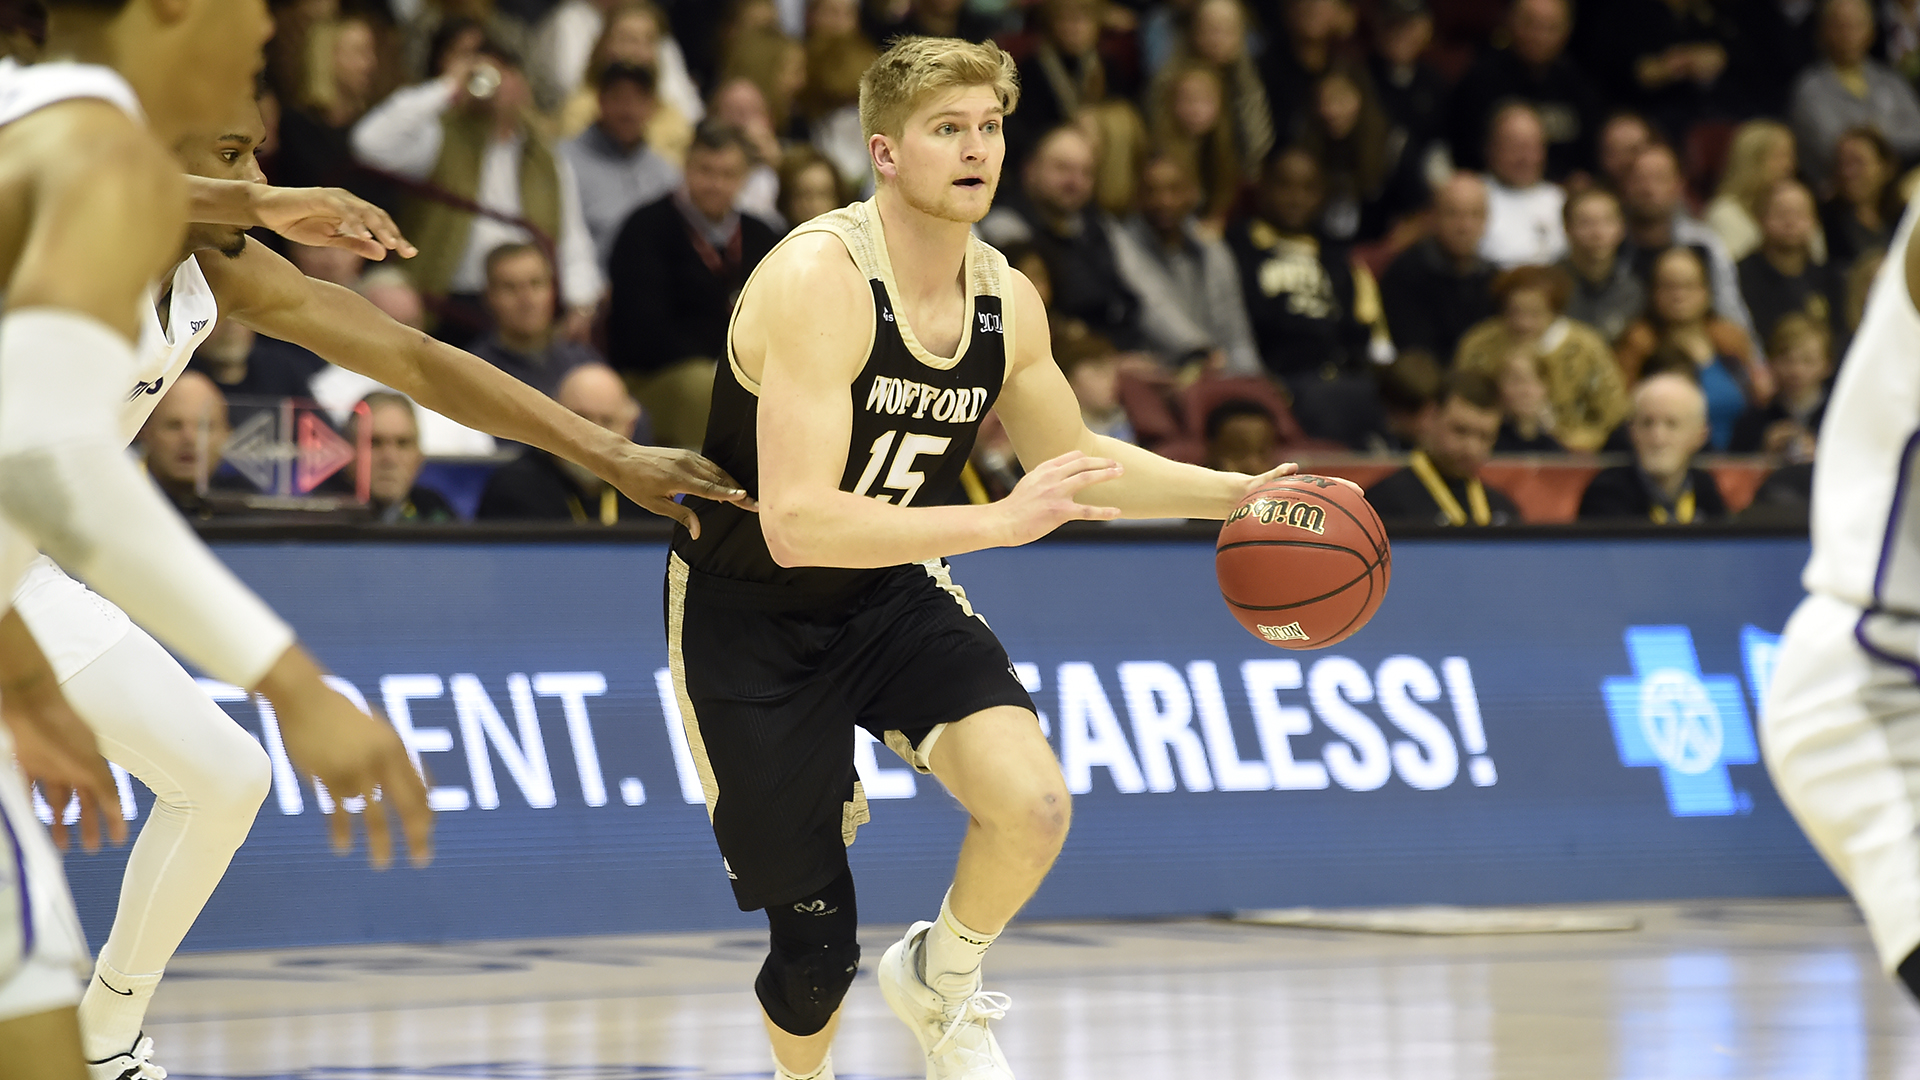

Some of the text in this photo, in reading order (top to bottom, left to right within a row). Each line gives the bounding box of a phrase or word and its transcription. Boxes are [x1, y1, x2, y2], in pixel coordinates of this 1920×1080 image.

[865, 374, 988, 424] WOFFORD
[852, 429, 952, 508] 15
[1256, 621, 1311, 641] SOCON
[943, 655, 1498, 797] ARLESS!
